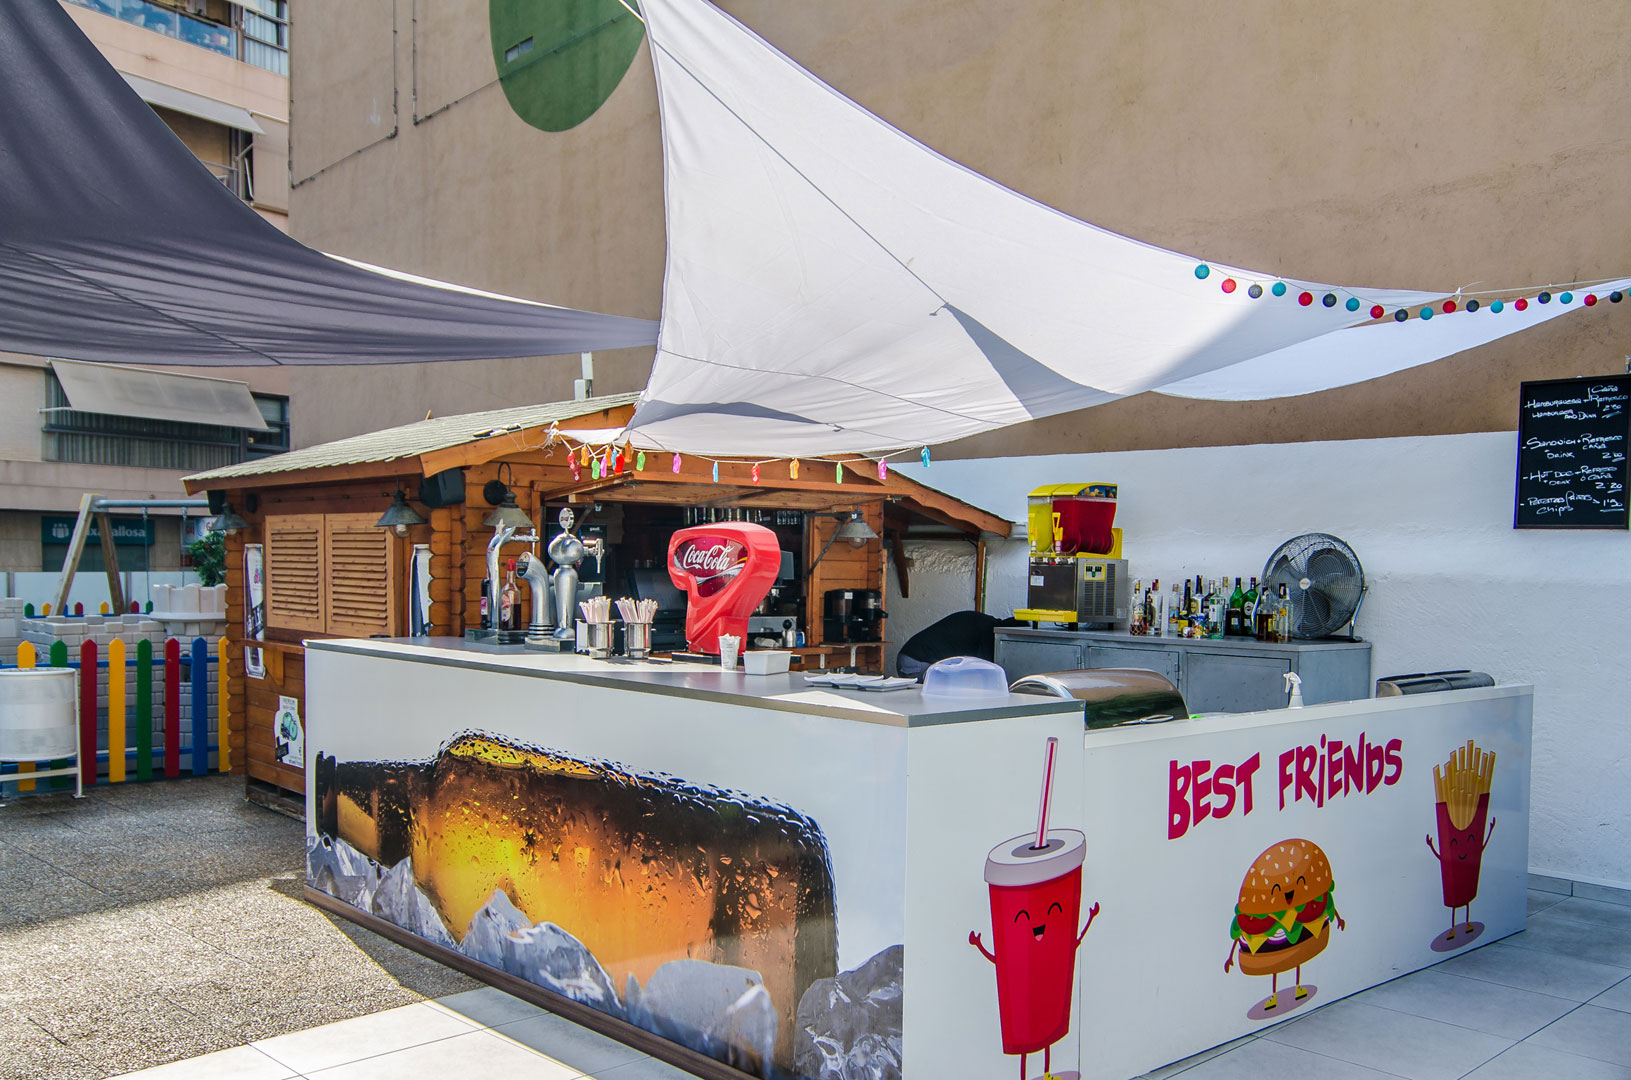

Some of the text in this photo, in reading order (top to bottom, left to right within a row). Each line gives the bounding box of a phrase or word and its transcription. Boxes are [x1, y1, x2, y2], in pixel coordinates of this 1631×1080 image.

[110, 525, 146, 537] allosa
[683, 544, 734, 570] Coca-Cola
[1168, 751, 1260, 840] BEST
